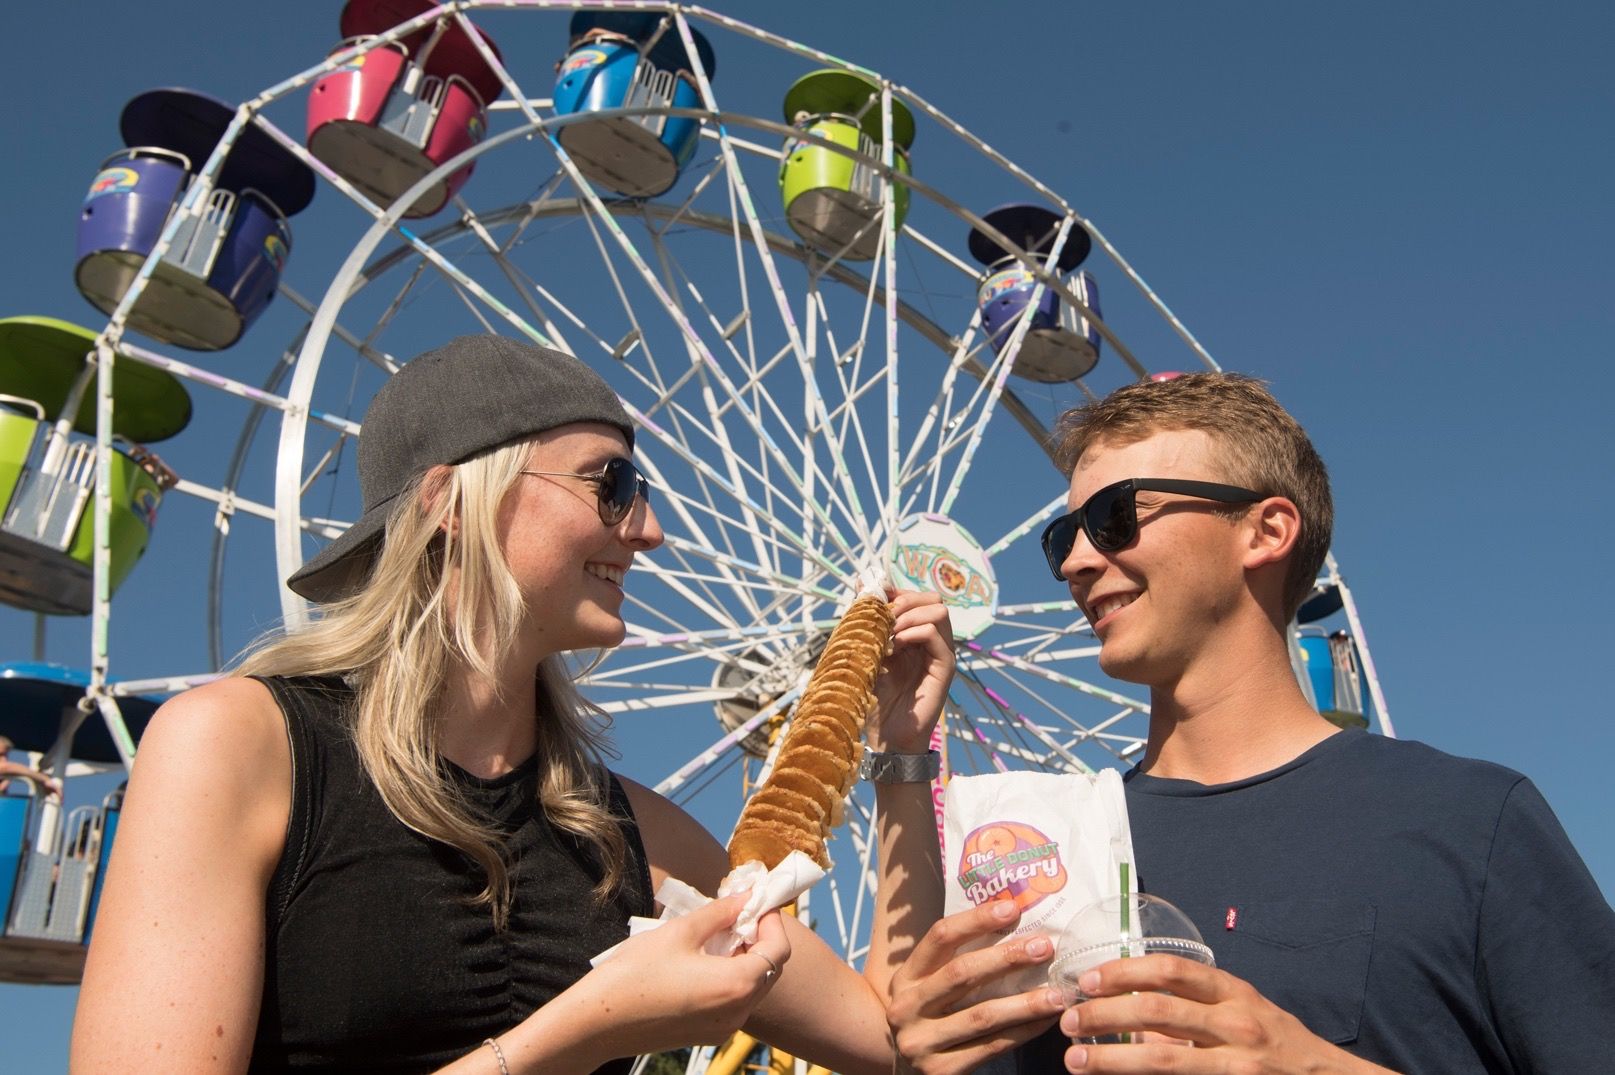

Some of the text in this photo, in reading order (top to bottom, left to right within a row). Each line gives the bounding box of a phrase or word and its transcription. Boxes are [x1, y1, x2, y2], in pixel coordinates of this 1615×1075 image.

[959, 842, 1059, 889] LITTLE DONUT
[966, 850, 995, 867] The
[966, 857, 1058, 906] Bakery
